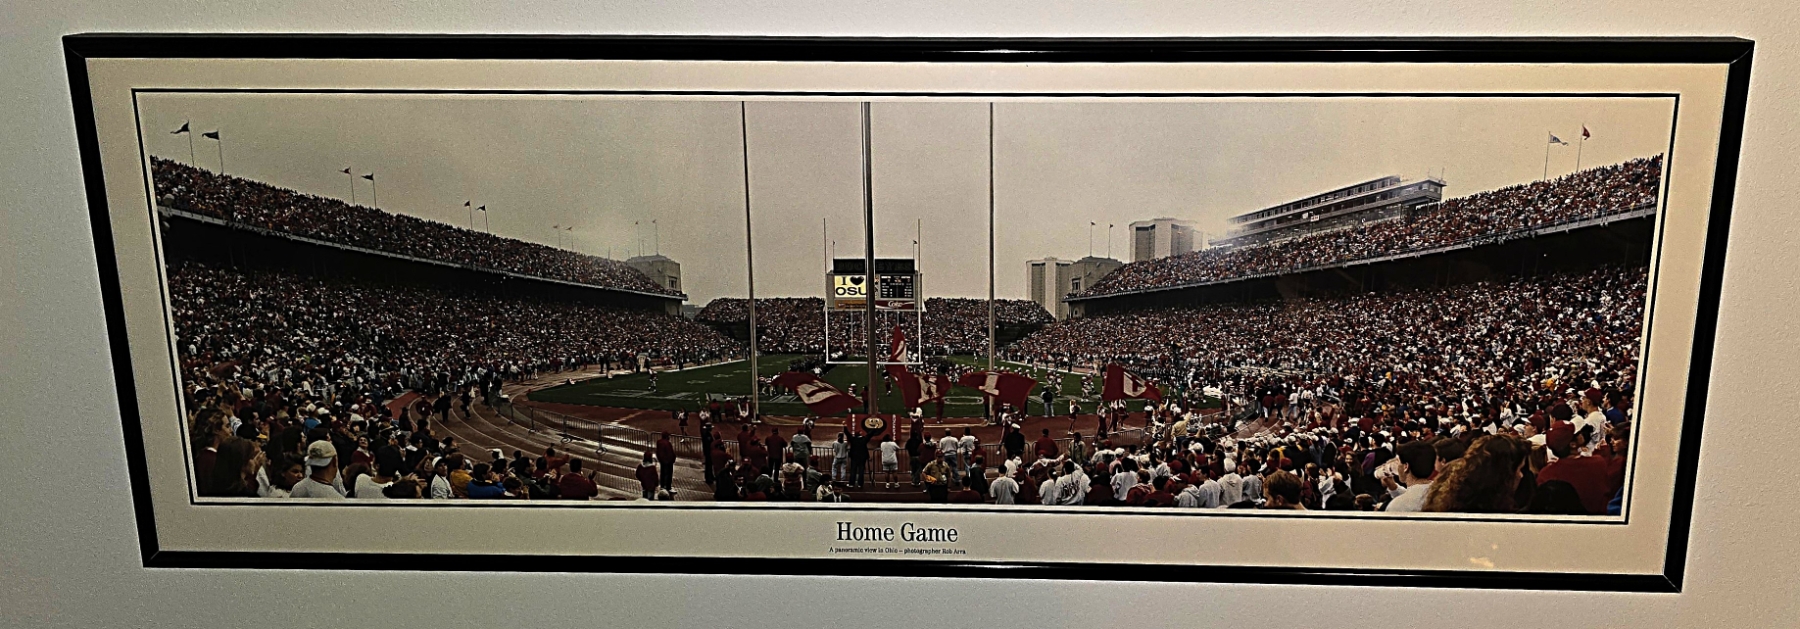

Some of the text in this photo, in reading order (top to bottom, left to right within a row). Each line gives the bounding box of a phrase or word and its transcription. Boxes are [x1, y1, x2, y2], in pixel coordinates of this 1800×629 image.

[841, 276, 848, 286] I
[835, 286, 868, 296] OSU
[836, 521, 959, 543] Home Game
[904, 547, 941, 555] photographer
